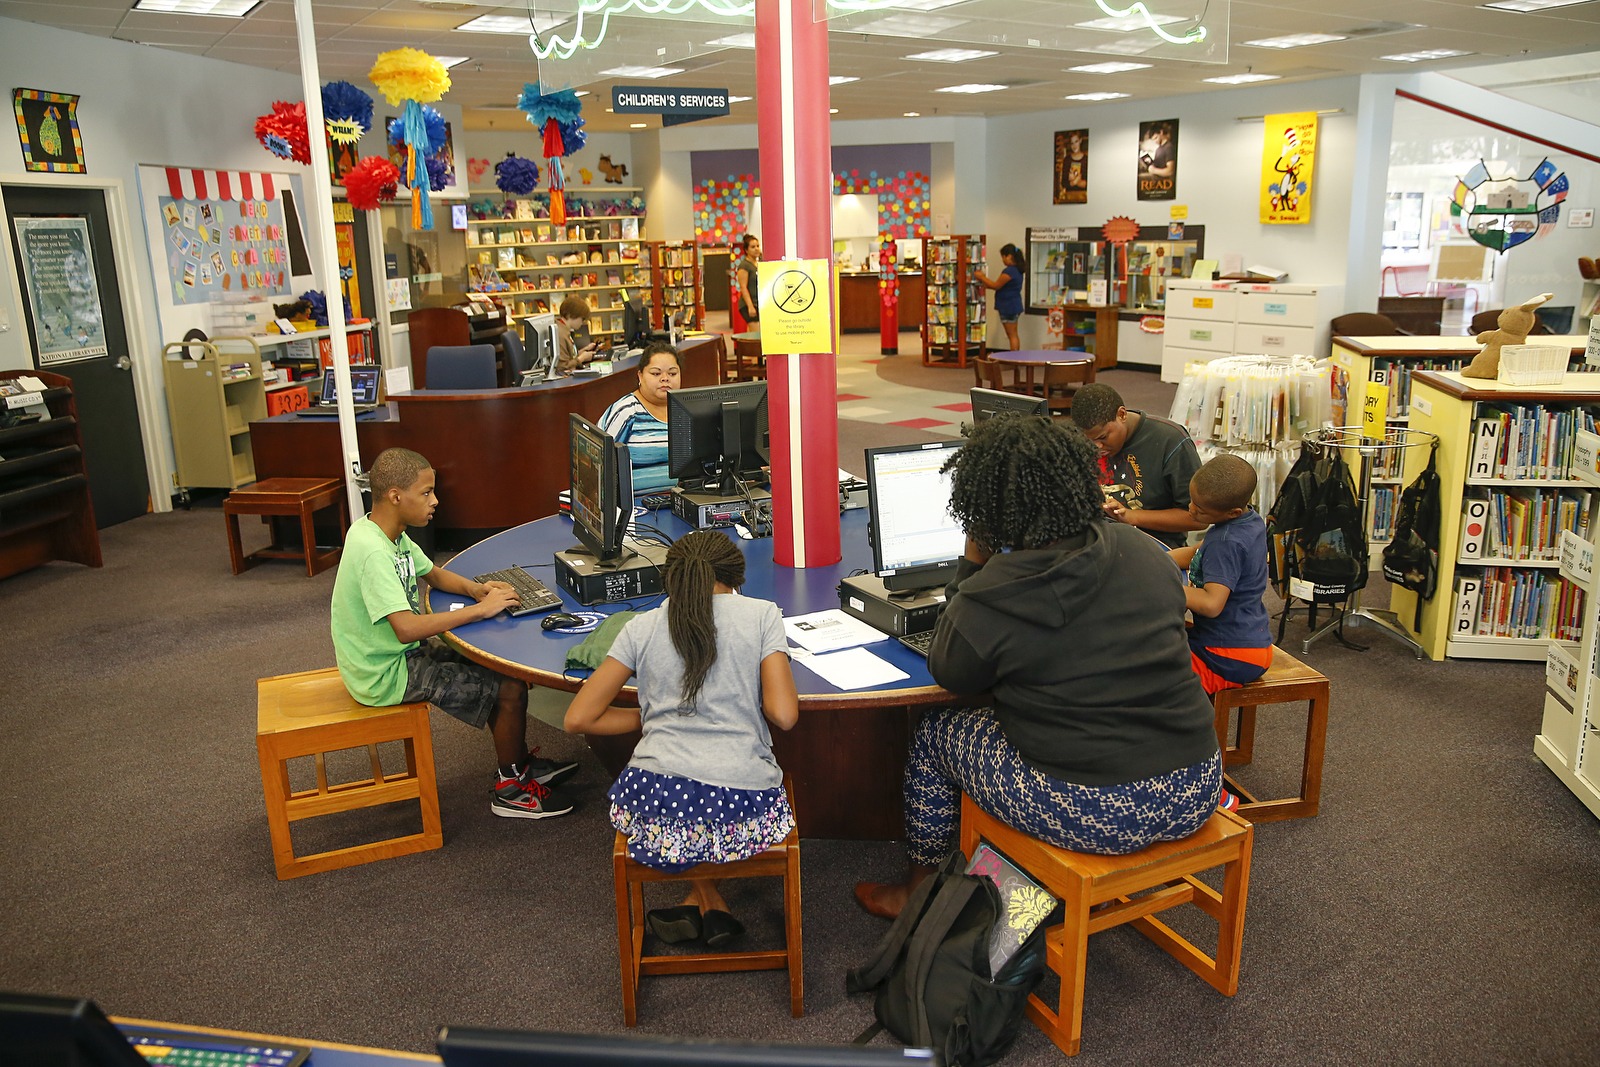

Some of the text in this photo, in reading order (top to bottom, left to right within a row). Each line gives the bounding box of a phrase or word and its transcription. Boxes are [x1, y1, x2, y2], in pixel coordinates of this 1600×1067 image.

[618, 93, 726, 108] CHILDREN'S SERVICES
[332, 125, 355, 135] WHAM!
[1141, 179, 1173, 191] READ
[229, 225, 284, 241] SMETHNG
[231, 247, 286, 266] COL THIS
[41, 352, 67, 361] NATIONAL
[1374, 372, 1384, 383] B
[1481, 422, 1497, 437] N
[1477, 462, 1488, 473] n
[1470, 503, 1485, 518] O
[1466, 542, 1477, 553] o
[1463, 582, 1476, 596] P
[1458, 619, 1470, 632] p
